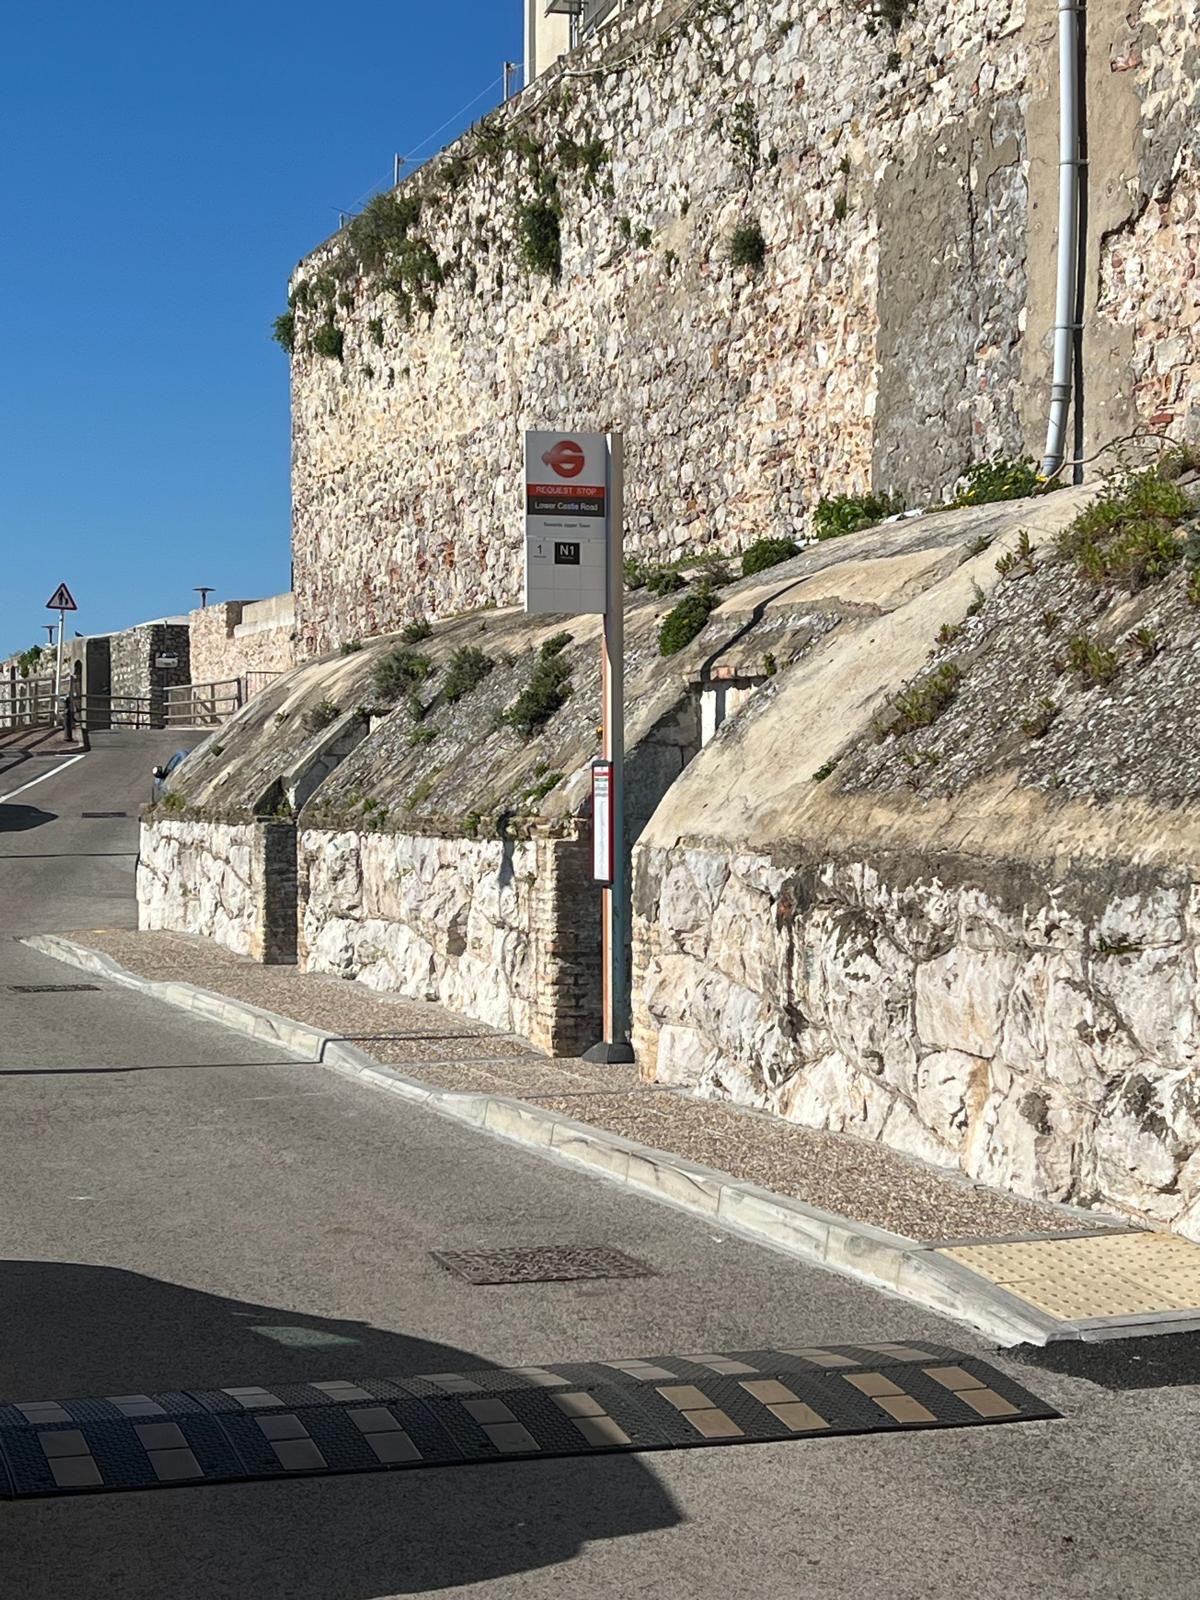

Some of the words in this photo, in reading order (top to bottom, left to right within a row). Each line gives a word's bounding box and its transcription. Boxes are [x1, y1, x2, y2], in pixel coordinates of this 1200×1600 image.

[536, 486, 573, 495] REQUEST
[576, 487, 597, 496] STOP
[535, 501, 556, 510] Lower
[557, 502, 579, 511] Castle
[580, 502, 598, 511] Road
[537, 544, 542, 554] 1
[560, 544, 574, 555] N1
